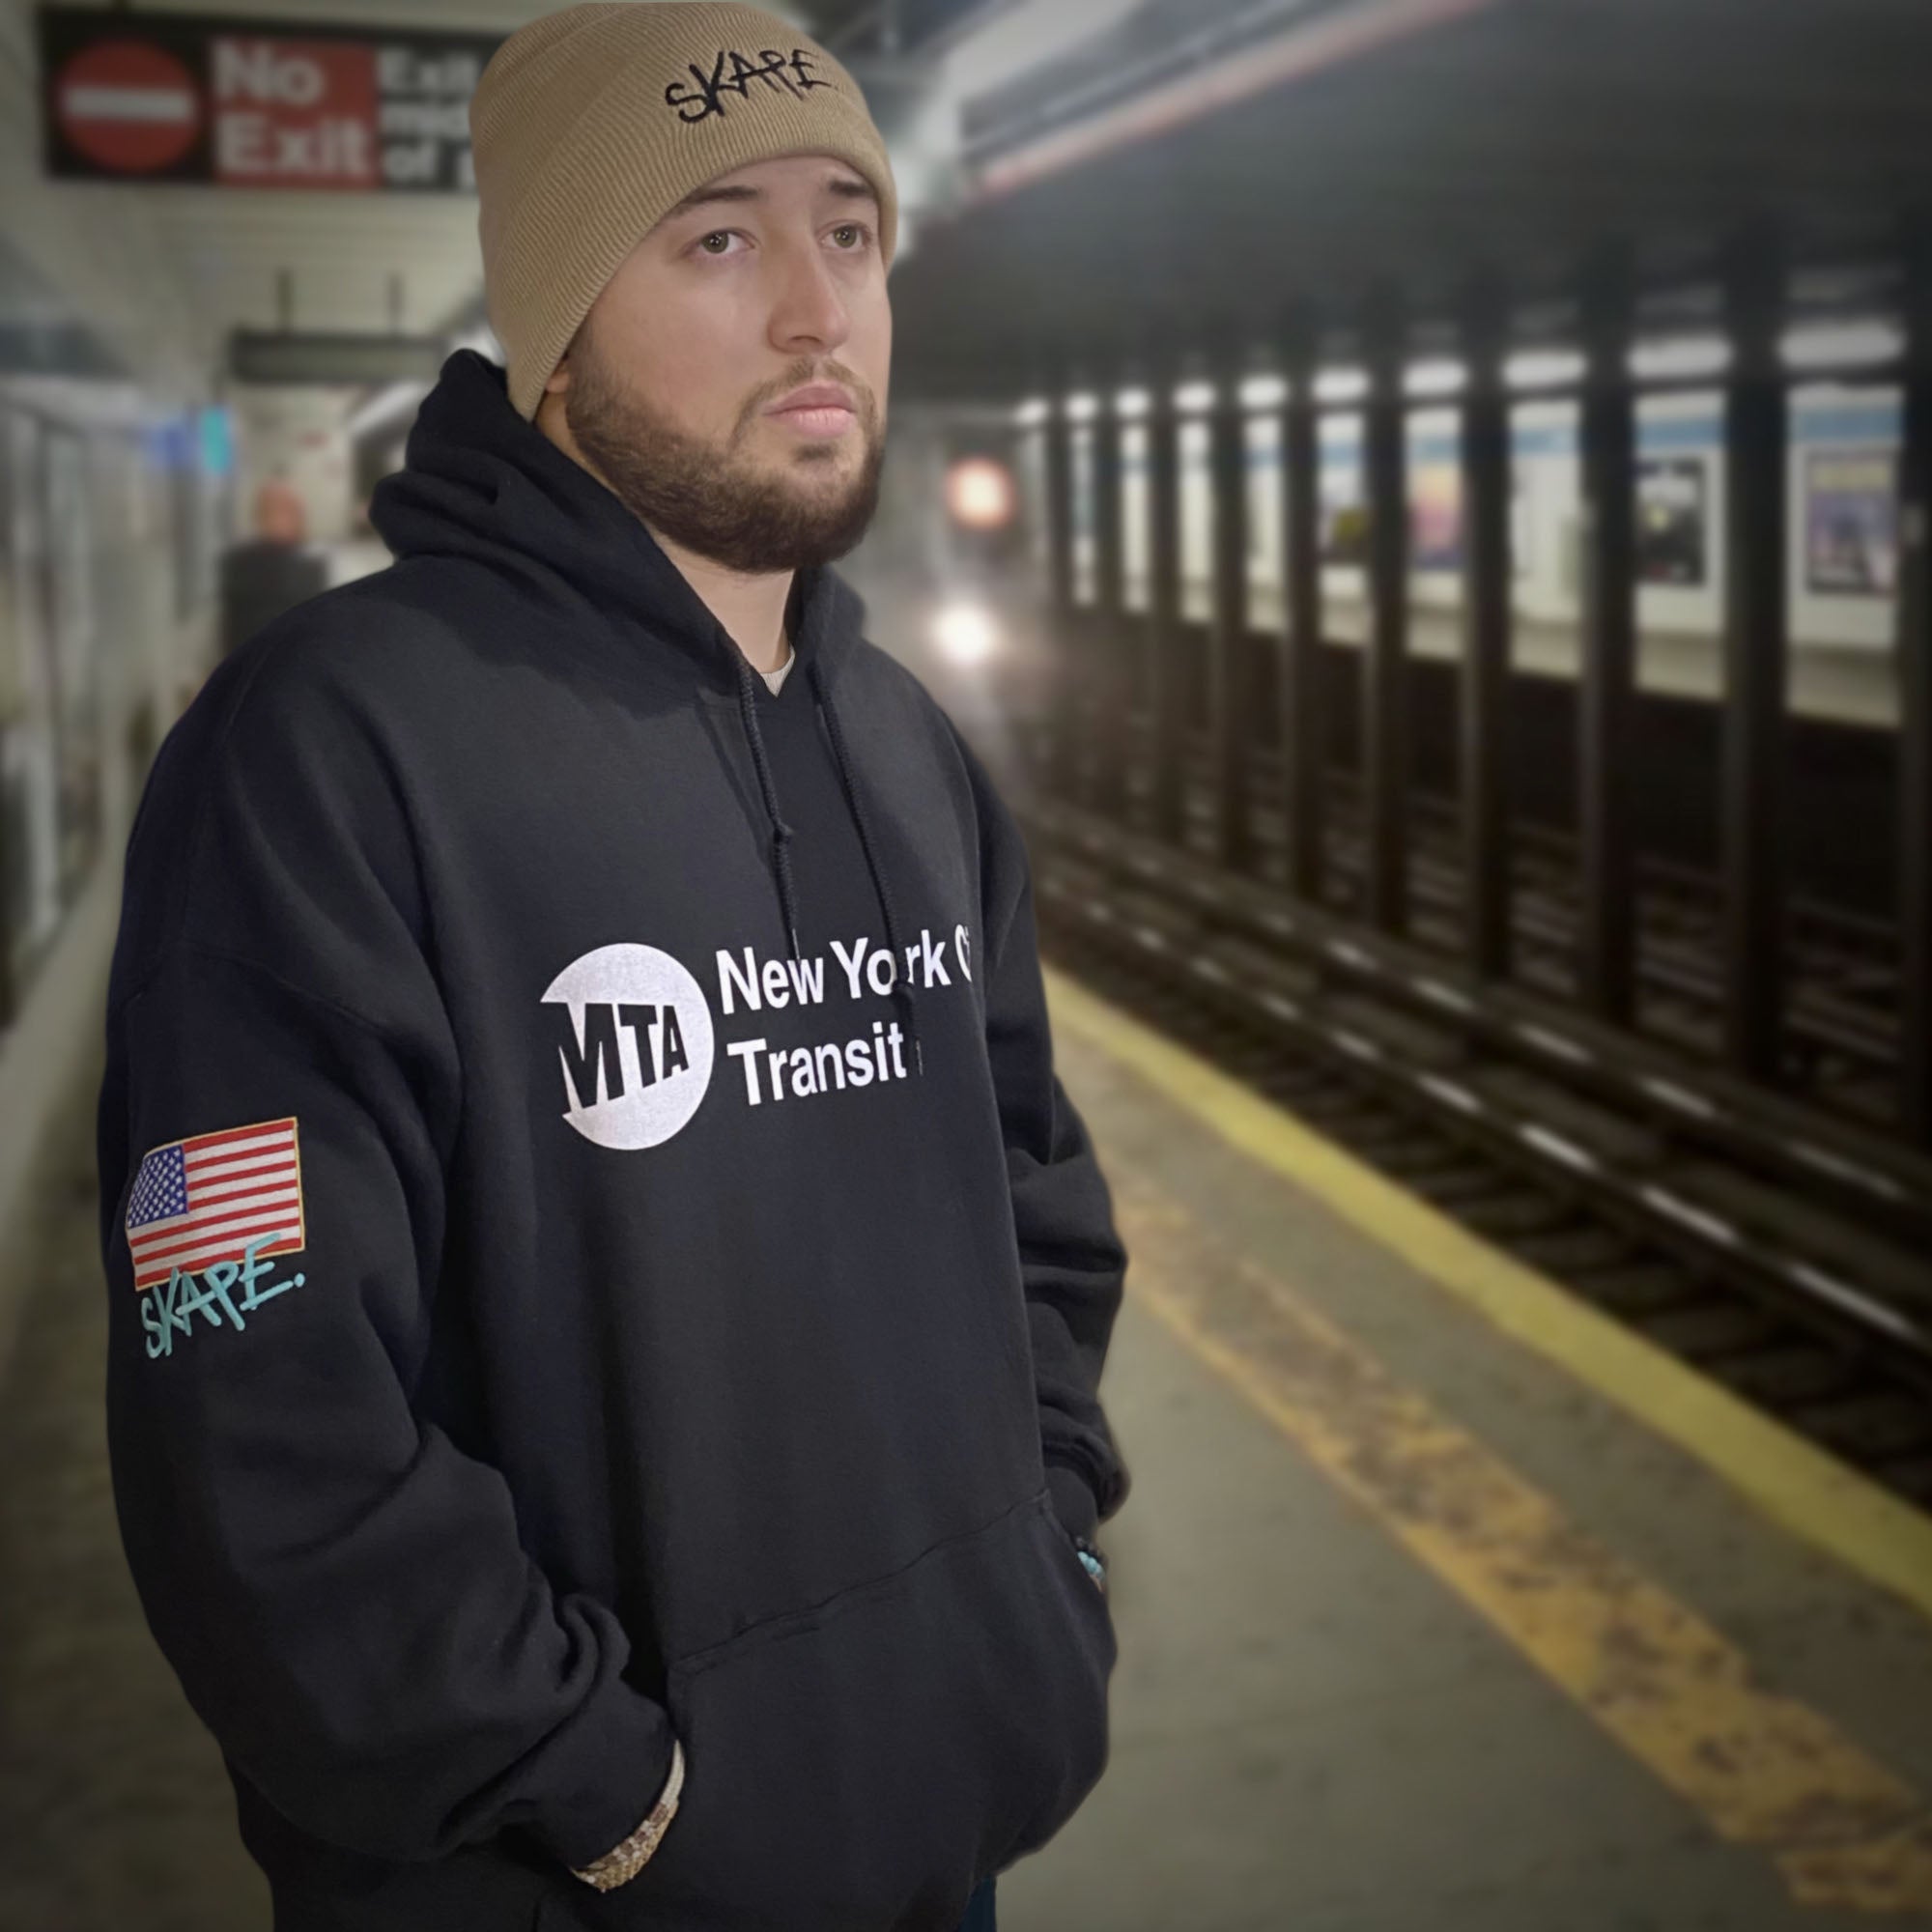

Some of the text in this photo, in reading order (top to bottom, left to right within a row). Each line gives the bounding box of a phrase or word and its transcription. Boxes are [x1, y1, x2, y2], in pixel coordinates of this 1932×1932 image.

[212, 38, 325, 104] No
[214, 112, 370, 178] Exit
[716, 946, 824, 1014] New
[829, 928, 952, 1000] York
[559, 1002, 689, 1109] MTA
[726, 1021, 907, 1106] Transit
